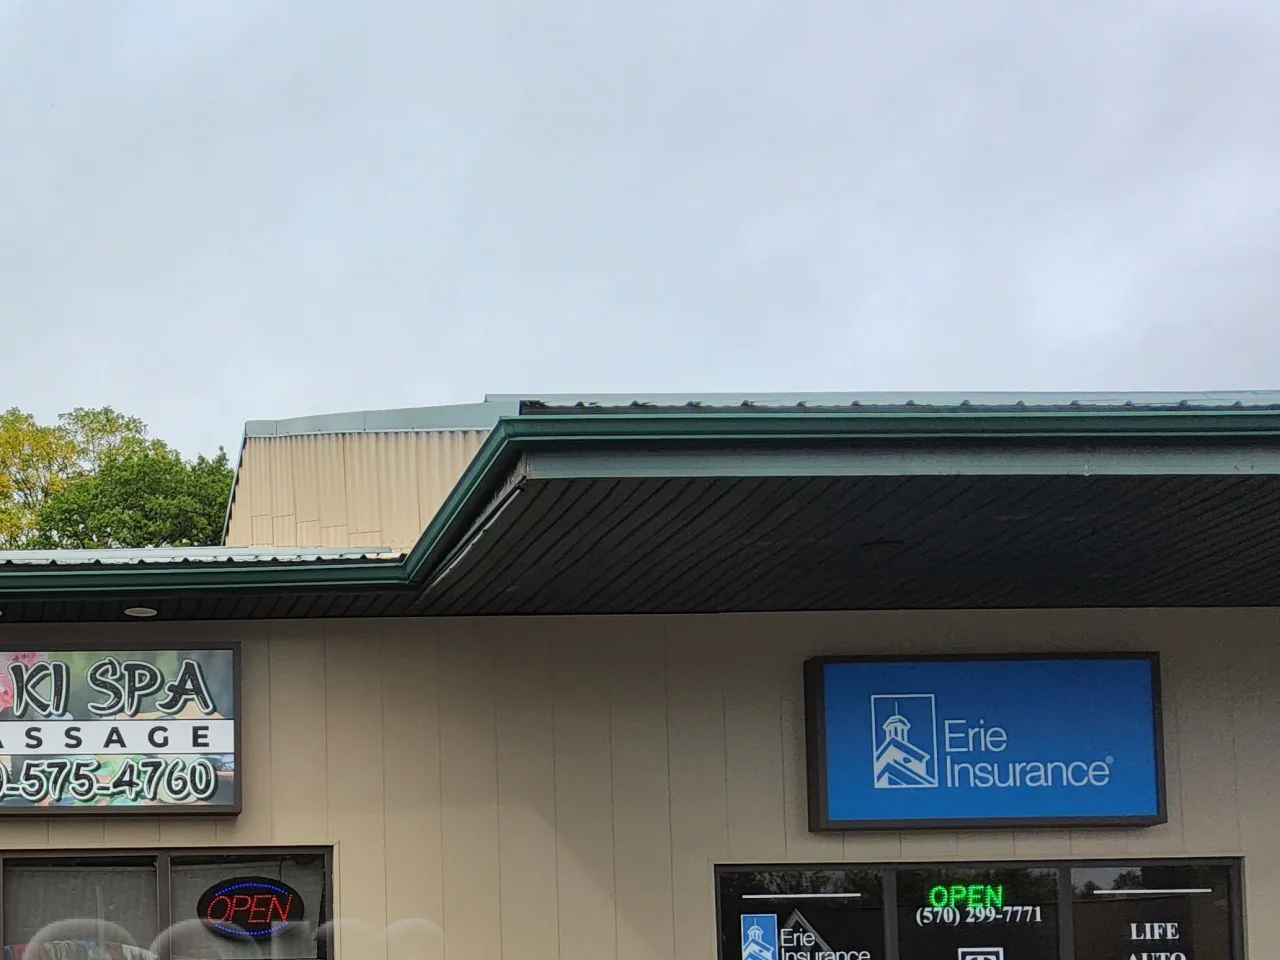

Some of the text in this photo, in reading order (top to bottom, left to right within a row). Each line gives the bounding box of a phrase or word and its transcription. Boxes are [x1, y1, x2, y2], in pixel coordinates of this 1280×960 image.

[7, 660, 70, 717] KI
[86, 656, 217, 717] SPA
[944, 718, 1007, 752] Erie
[928, 884, 1004, 907] OPEN
[207, 893, 293, 924] OPEN
[916, 906, 1042, 927] (570) 299-7771
[780, 928, 816, 947] Erie
[1130, 922, 1180, 940] LIFE
